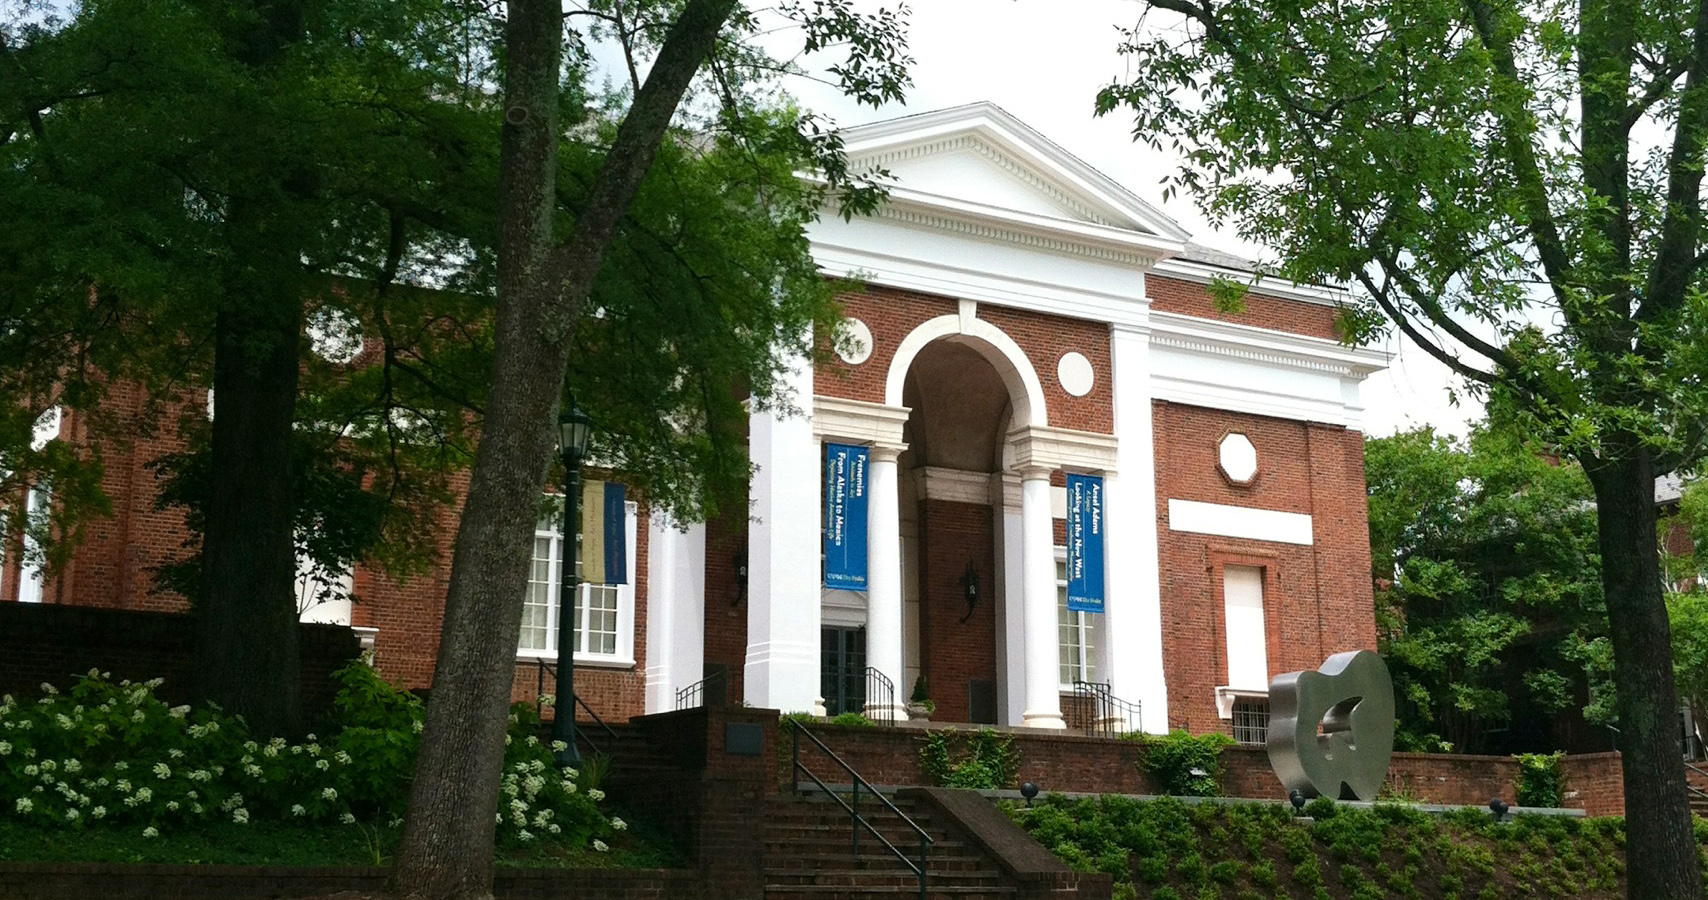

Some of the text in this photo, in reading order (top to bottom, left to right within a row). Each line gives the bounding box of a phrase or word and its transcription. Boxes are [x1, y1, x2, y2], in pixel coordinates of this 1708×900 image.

[856, 454, 866, 496] Frenemies
[835, 452, 846, 546] From Alaska to Mexico
[1073, 482, 1082, 513] Looking
[1075, 513, 1081, 522] at
[1092, 483, 1100, 534] Ansel Adams
